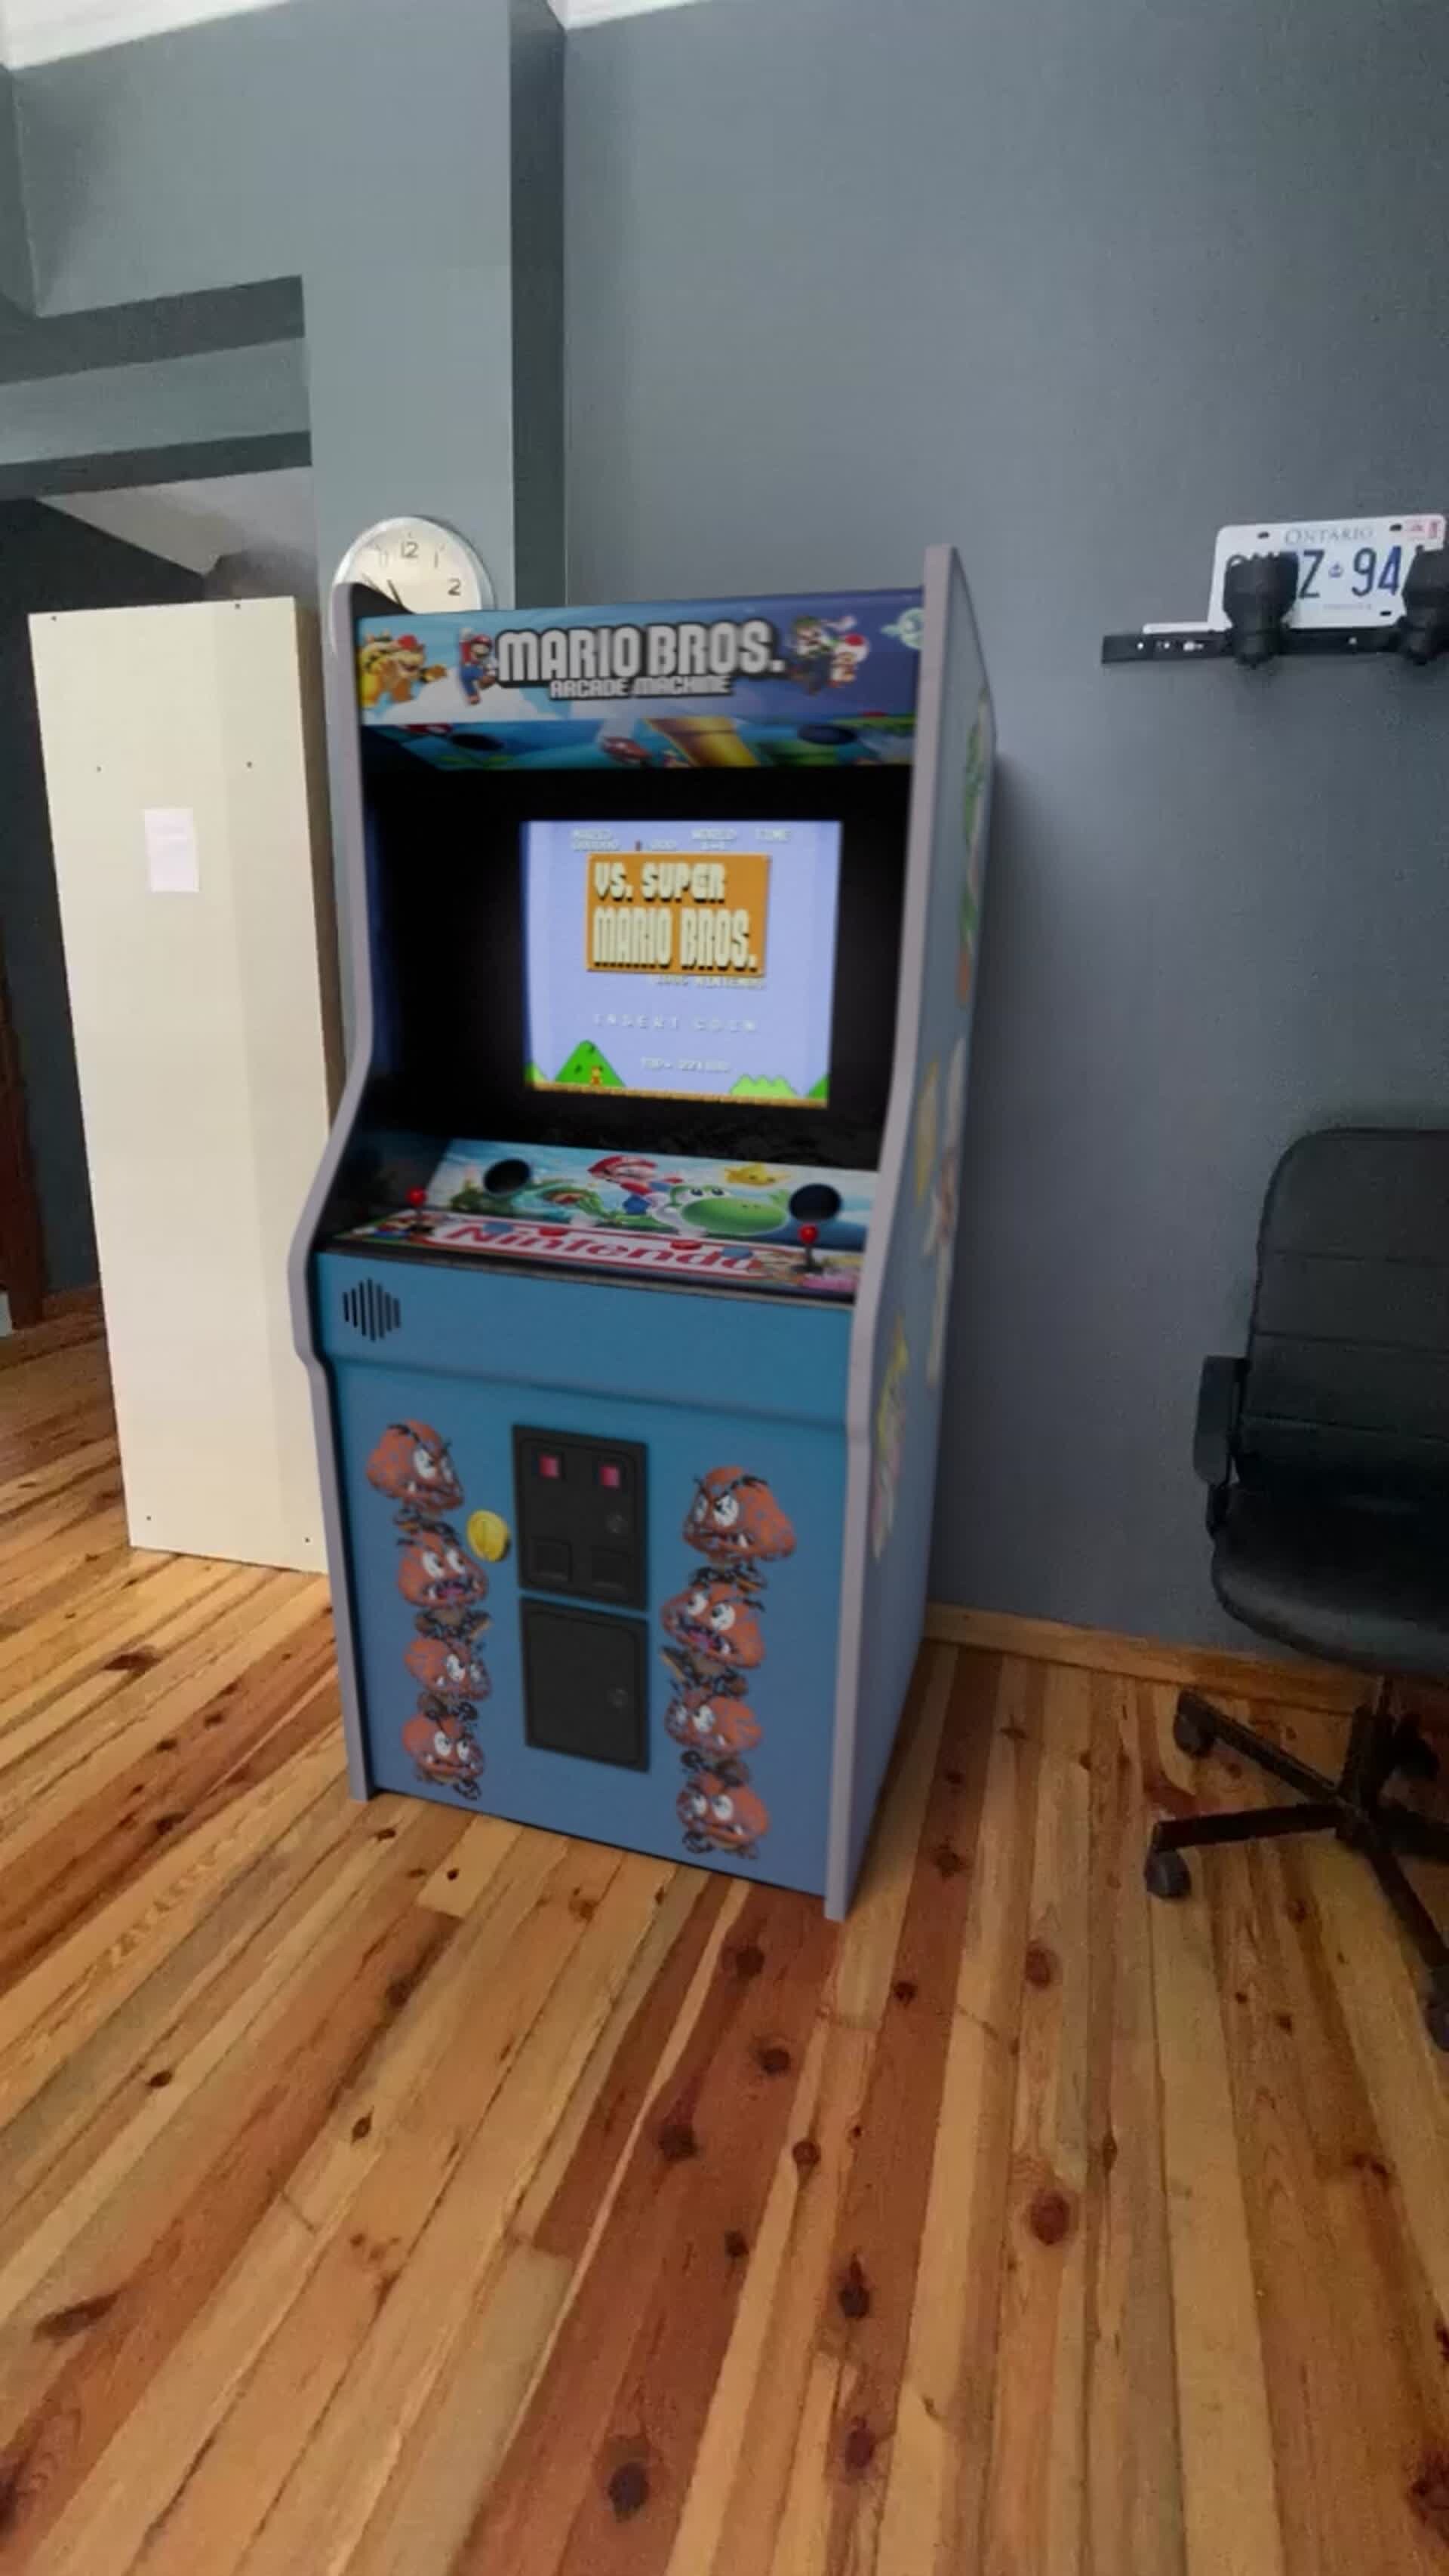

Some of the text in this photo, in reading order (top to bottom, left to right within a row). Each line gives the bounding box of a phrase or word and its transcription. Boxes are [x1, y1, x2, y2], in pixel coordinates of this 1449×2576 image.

[401, 541, 418, 559] 12
[1284, 526, 1374, 546] ONTARIO
[447, 579, 462, 596] 2
[497, 619, 786, 681] MARIO BROS.
[550, 675, 732, 699] ARCADE MACHINE
[593, 861, 726, 904] VS. SUPER
[592, 906, 758, 973] MARIO BROS.
[446, 1225, 763, 1270] Nintendo
